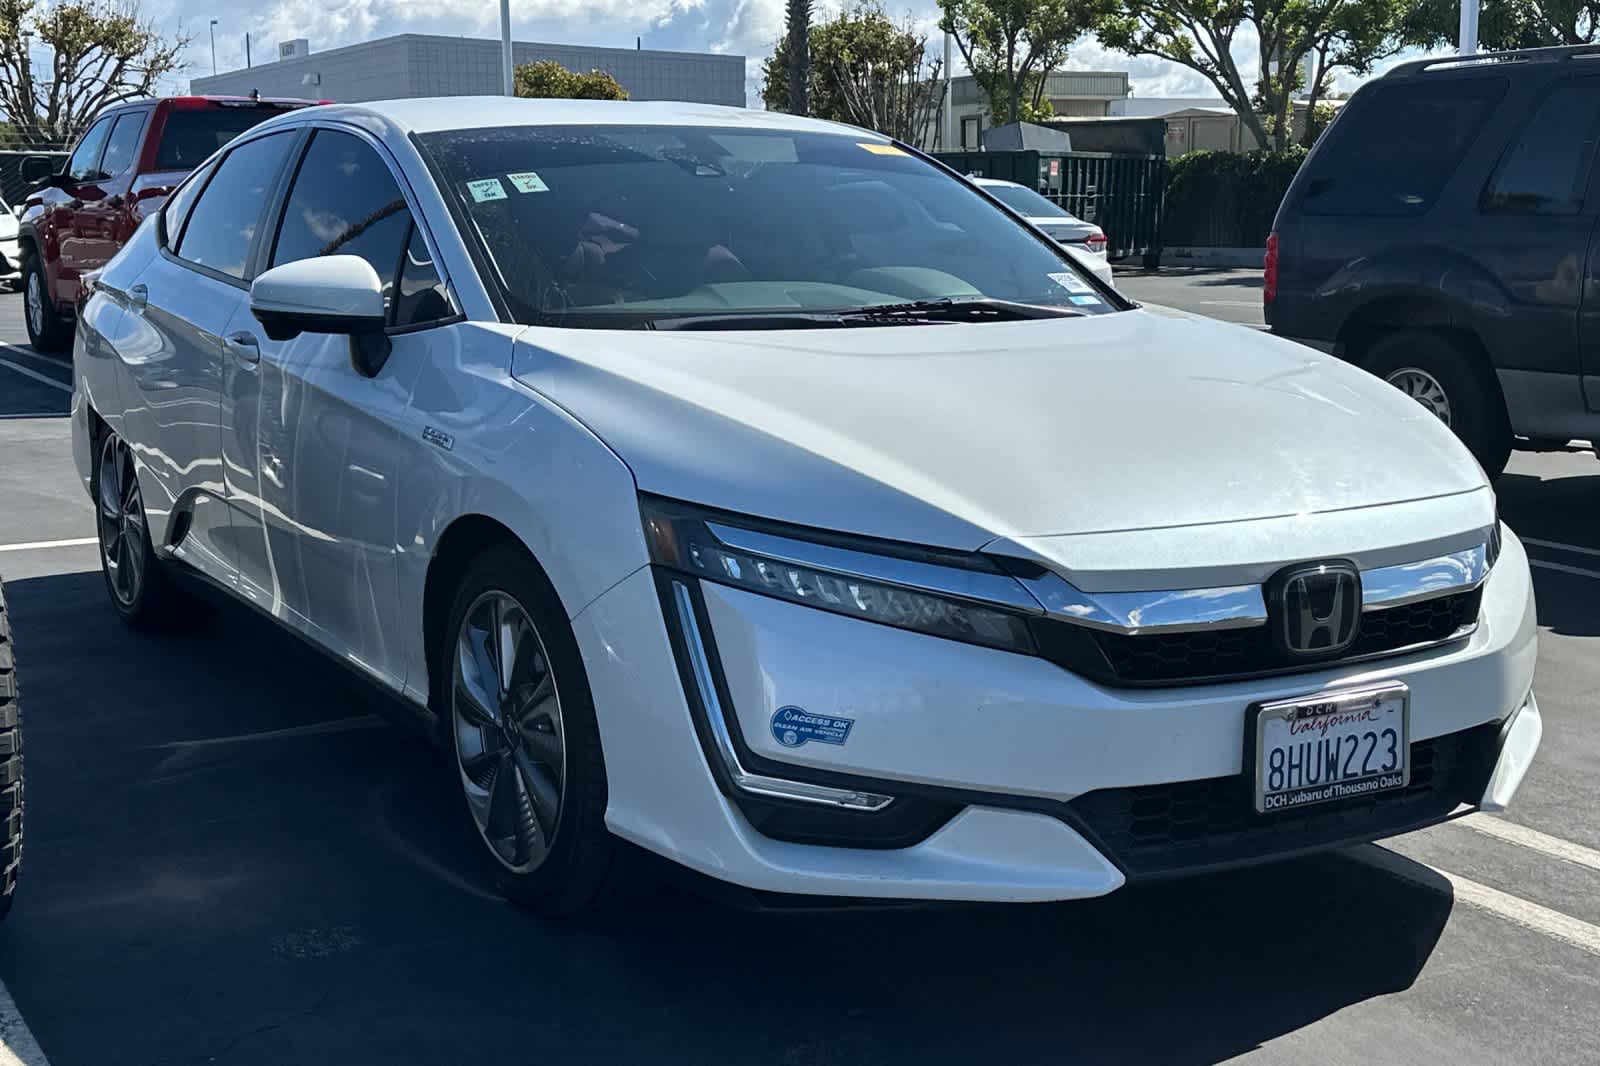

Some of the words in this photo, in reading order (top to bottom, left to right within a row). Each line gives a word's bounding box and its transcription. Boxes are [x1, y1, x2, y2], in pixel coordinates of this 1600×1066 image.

[1305, 704, 1333, 716] DCH
[774, 721, 799, 731] CLEAN
[799, 726, 813, 734] AIR
[791, 714, 830, 727] ACCESS
[833, 720, 849, 729] OK
[1289, 709, 1379, 738] California
[1268, 728, 1398, 791] 8HUW223
[1265, 794, 1288, 809] DCH
[1323, 785, 1334, 800] of
[1380, 774, 1402, 788] Oaks
